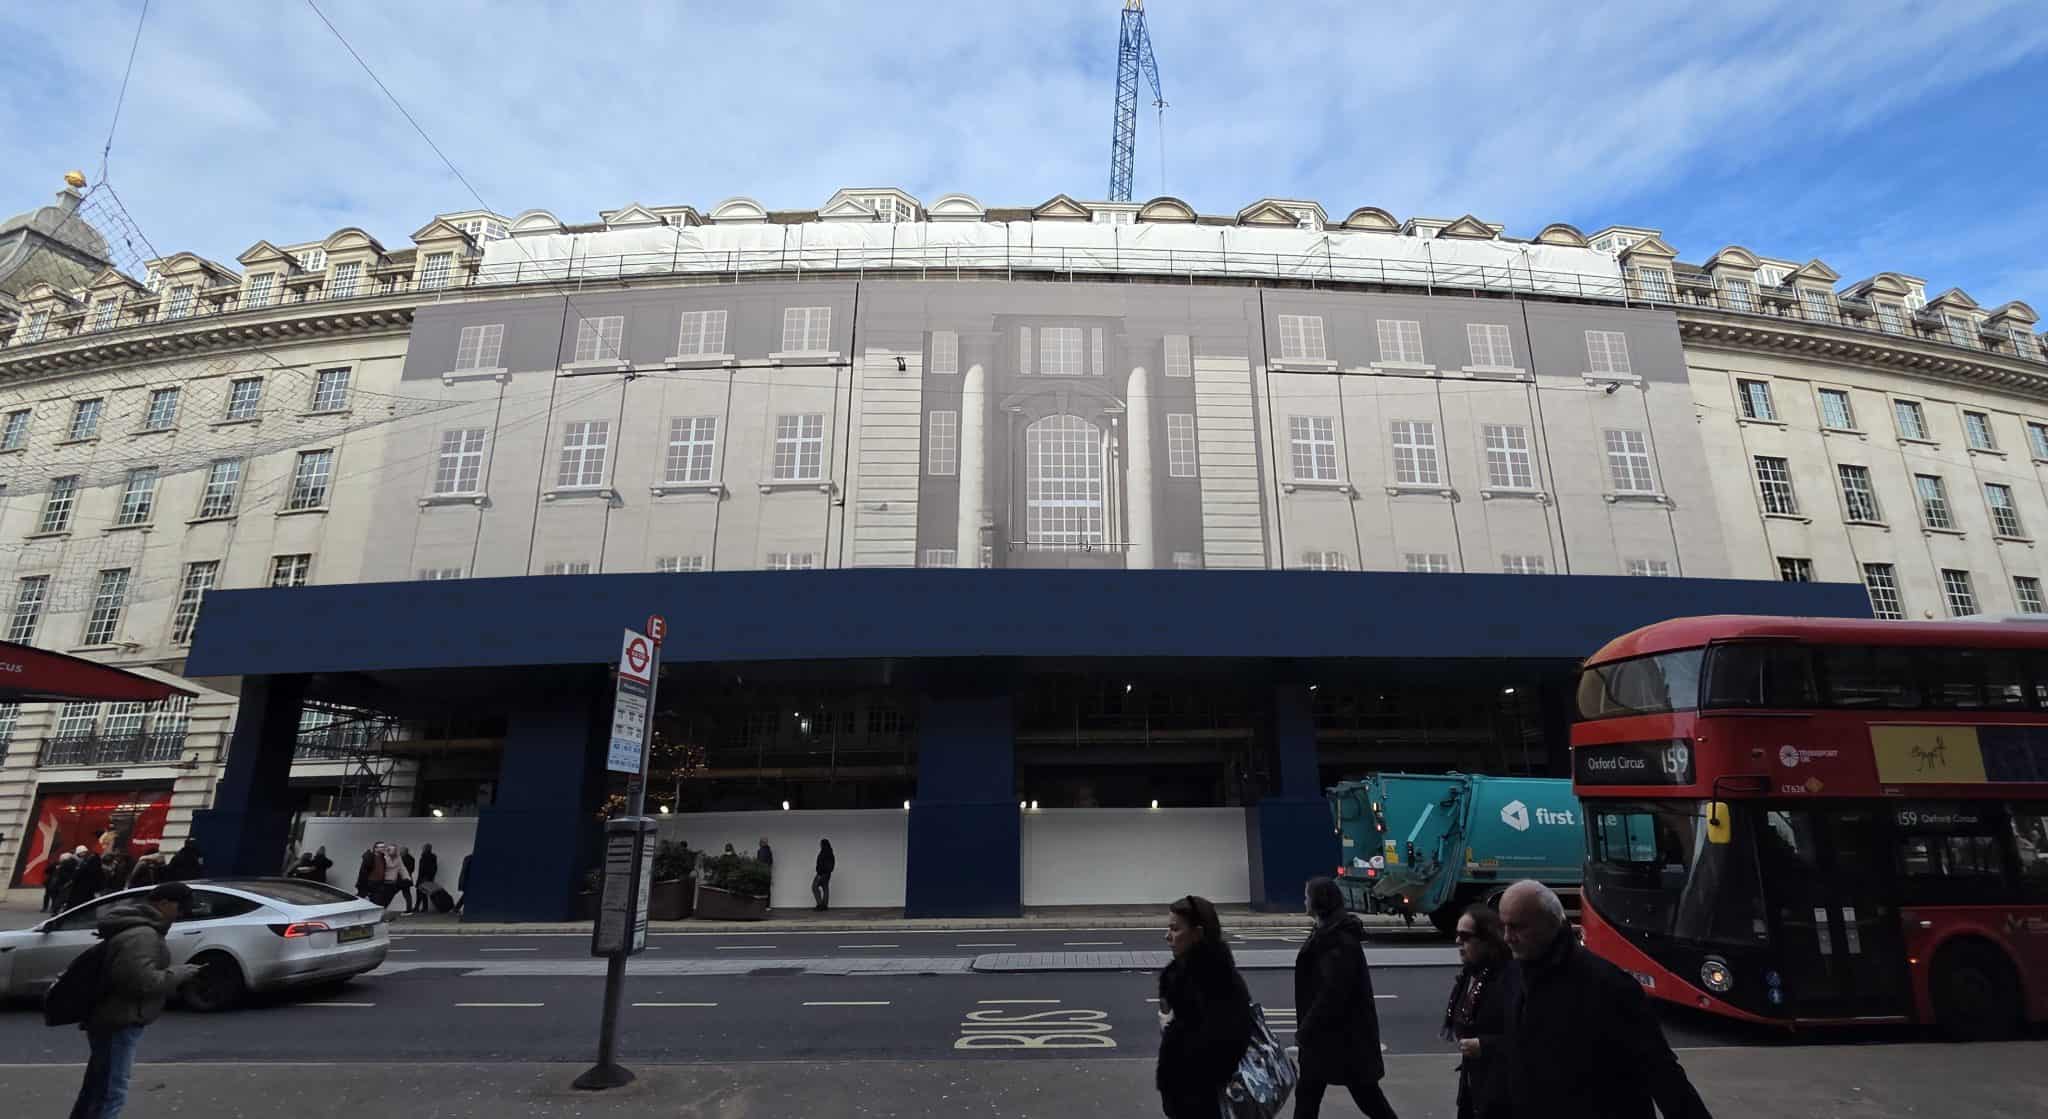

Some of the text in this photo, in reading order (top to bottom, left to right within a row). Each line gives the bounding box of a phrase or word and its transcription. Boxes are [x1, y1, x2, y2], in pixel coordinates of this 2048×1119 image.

[652, 618, 662, 638] E
[1587, 755, 1645, 771] Oxford Circus
[1661, 747, 1689, 774] 159
[1536, 807, 1575, 825] first
[1897, 811, 1918, 826] 159
[1921, 813, 1951, 824] Oxford
[953, 1009, 1118, 1049] BUS
